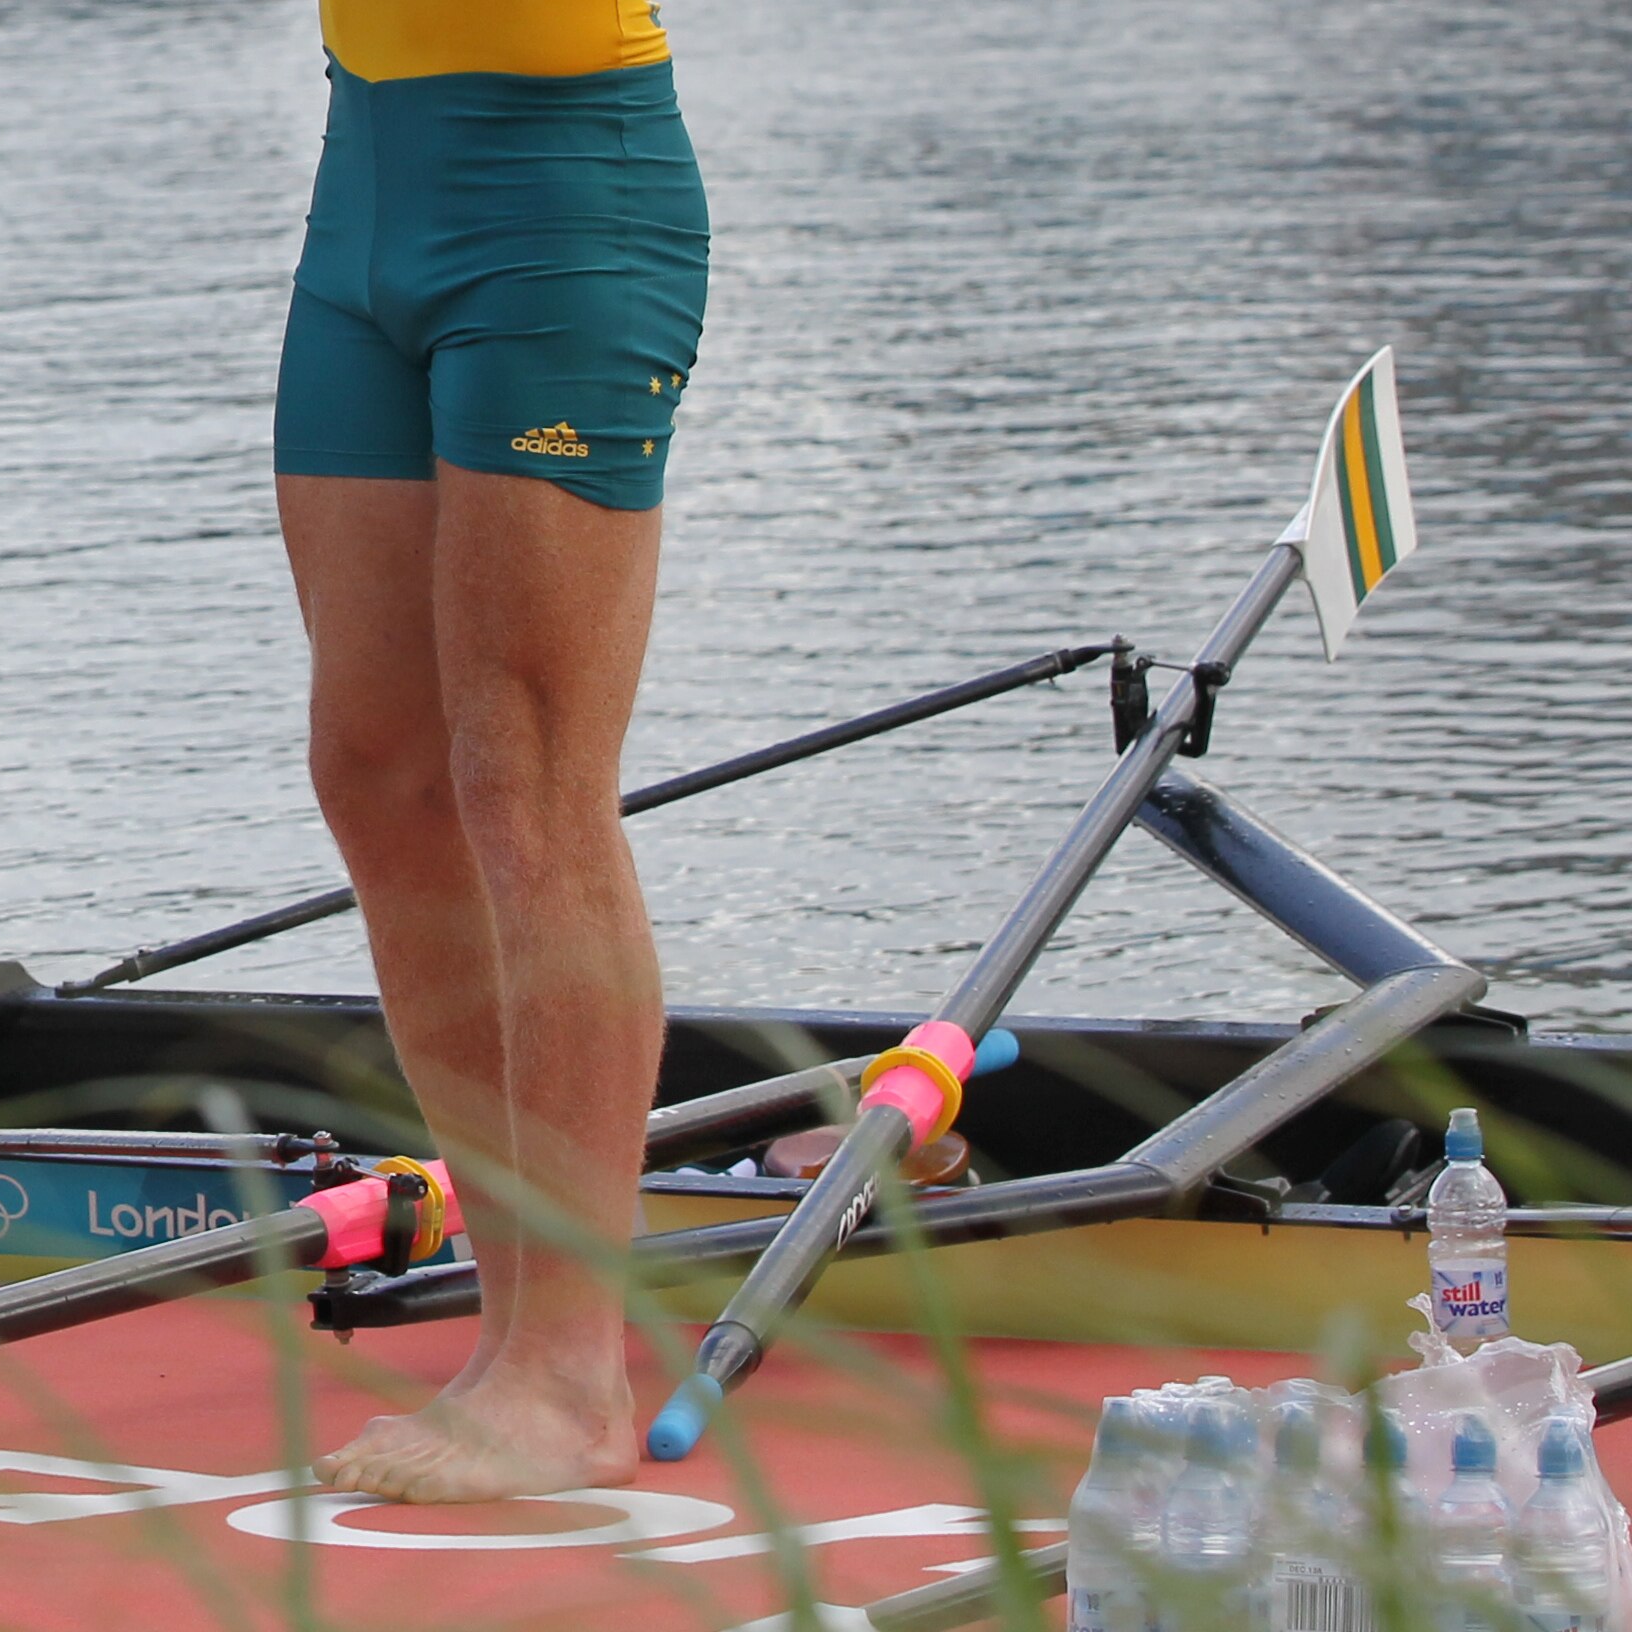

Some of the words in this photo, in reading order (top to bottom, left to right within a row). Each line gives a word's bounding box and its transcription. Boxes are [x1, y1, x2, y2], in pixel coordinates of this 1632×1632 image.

[510, 436, 590, 458] adidas
[1441, 1279, 1481, 1303] still
[1448, 1298, 1506, 1317] water
